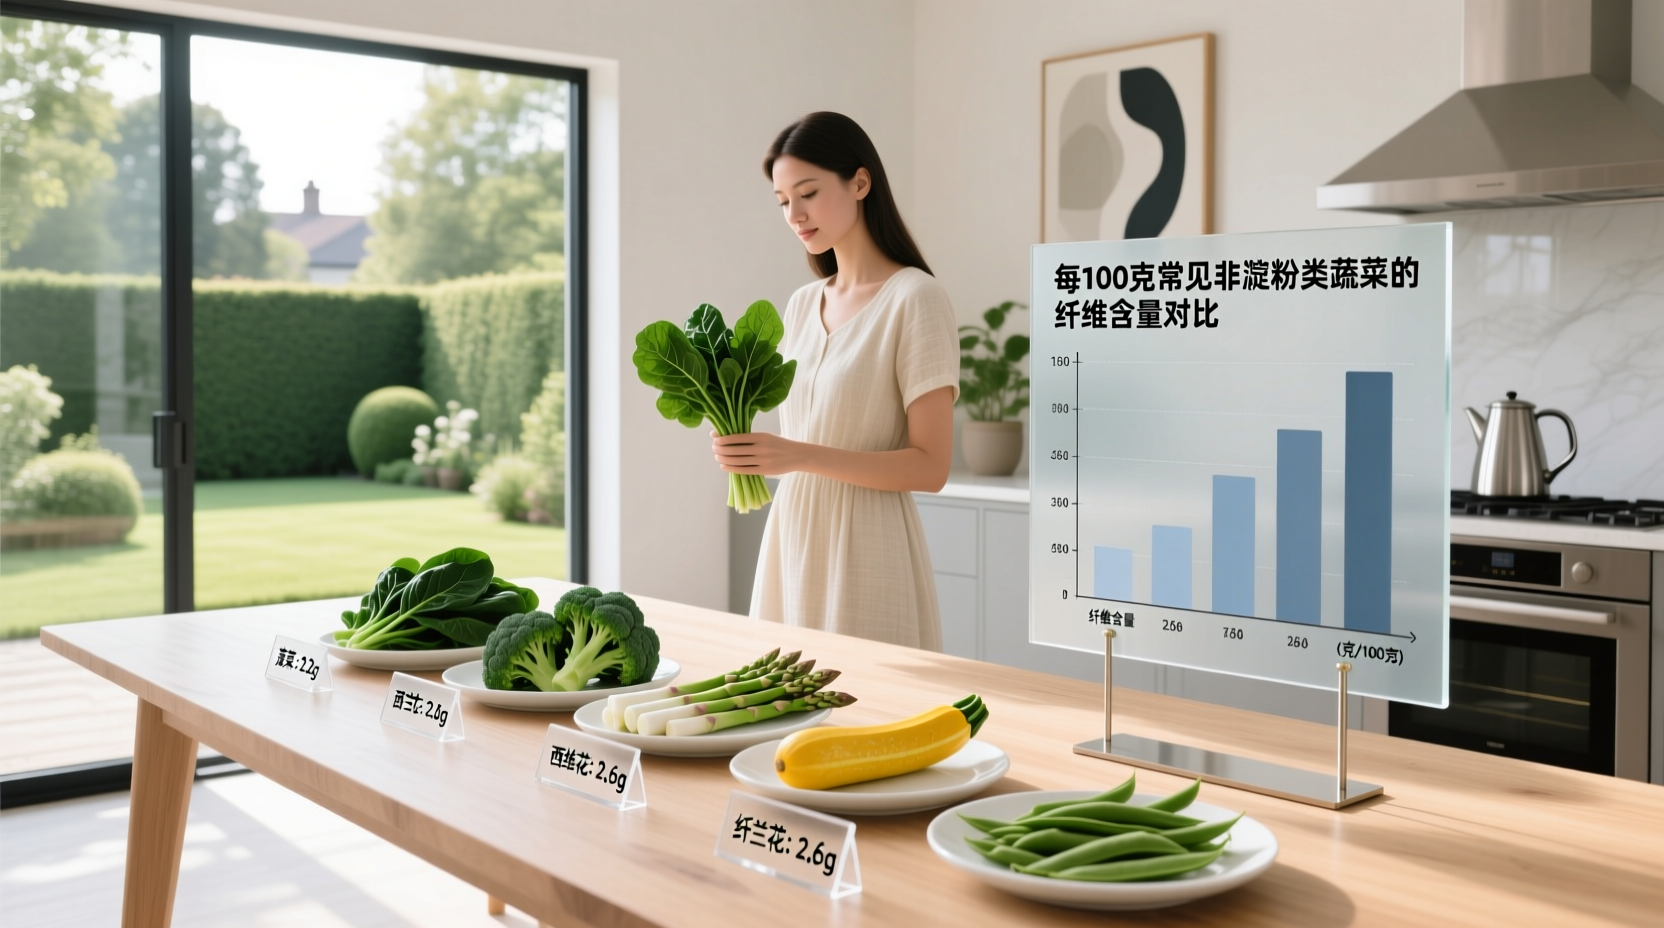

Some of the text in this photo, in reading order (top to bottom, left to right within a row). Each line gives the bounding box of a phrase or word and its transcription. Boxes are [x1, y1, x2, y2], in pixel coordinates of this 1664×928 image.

[1054, 298, 1219, 330] 纤维含量对比
